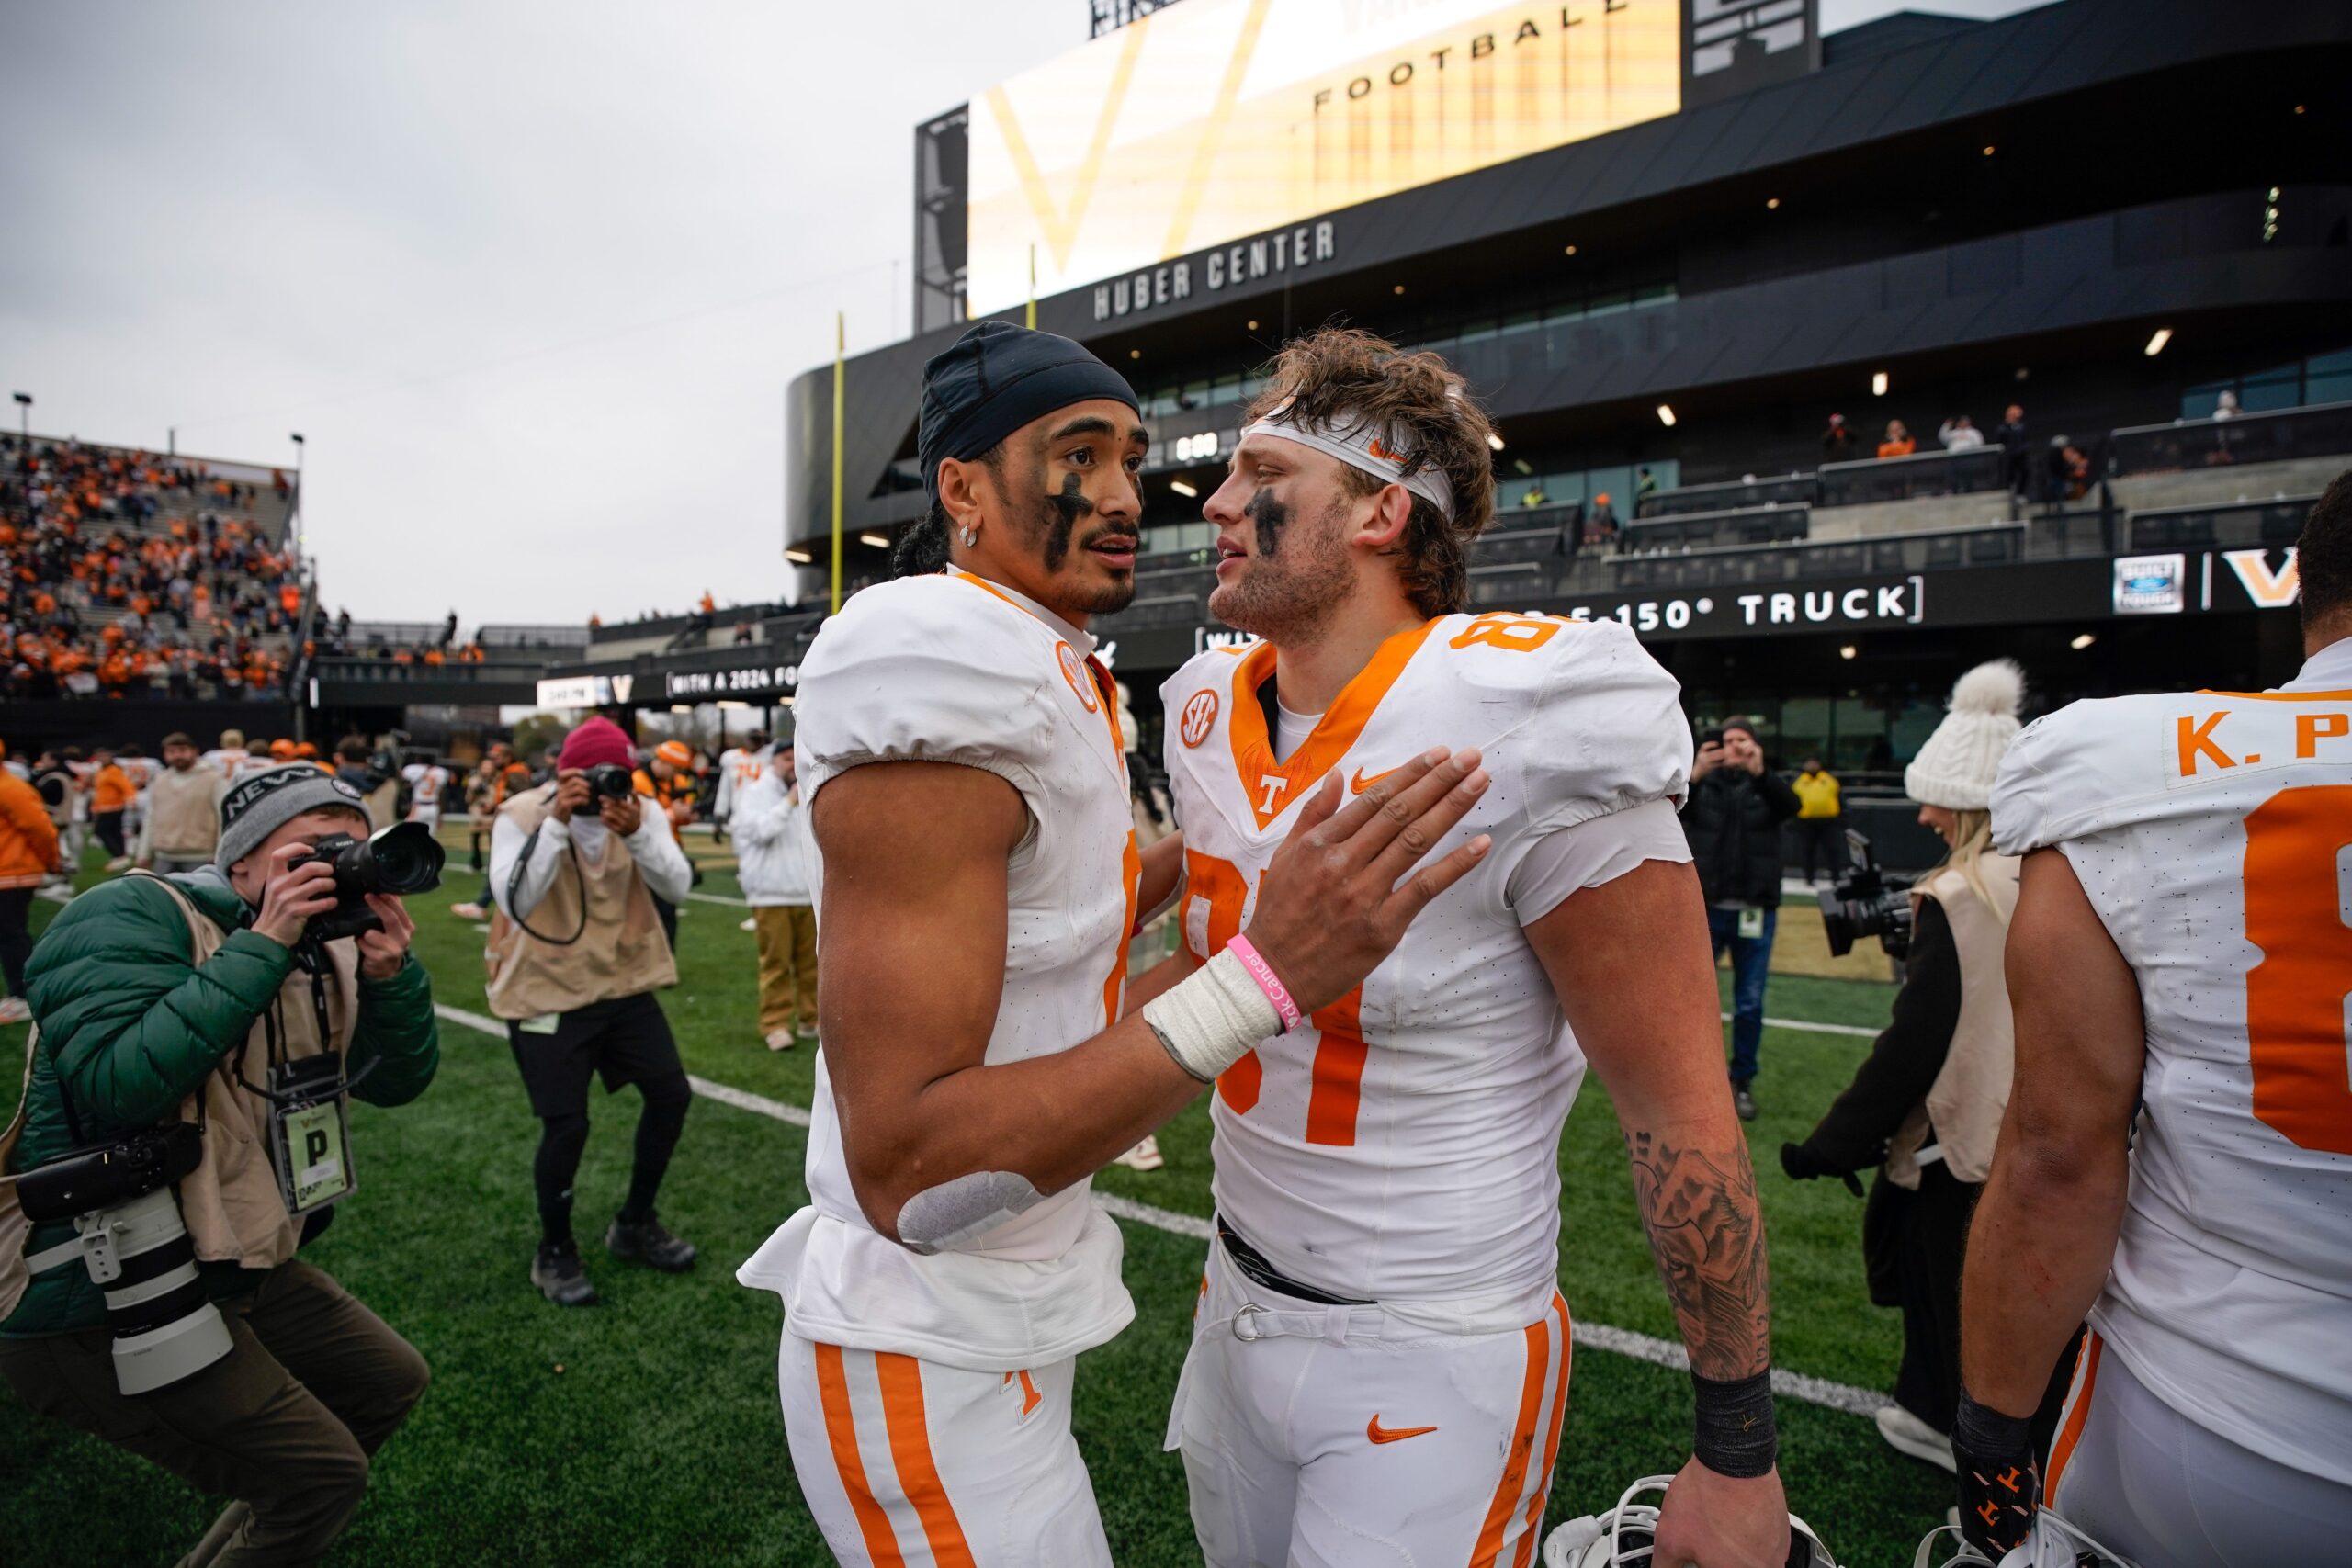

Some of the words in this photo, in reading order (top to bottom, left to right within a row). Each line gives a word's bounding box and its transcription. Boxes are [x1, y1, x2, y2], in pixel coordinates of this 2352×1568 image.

[1314, 0, 1629, 114] FOOTBALL
[1093, 261, 1192, 321] HUBER
[1206, 220, 1334, 290] CENTER
[714, 671, 727, 691] A
[729, 668, 771, 691] 2024
[1183, 693, 1216, 743] SEC
[2177, 710, 2261, 778] K.
[1258, 773, 1288, 815] T
[1245, 952, 1284, 1000] Cancer
[306, 1129, 328, 1168] P
